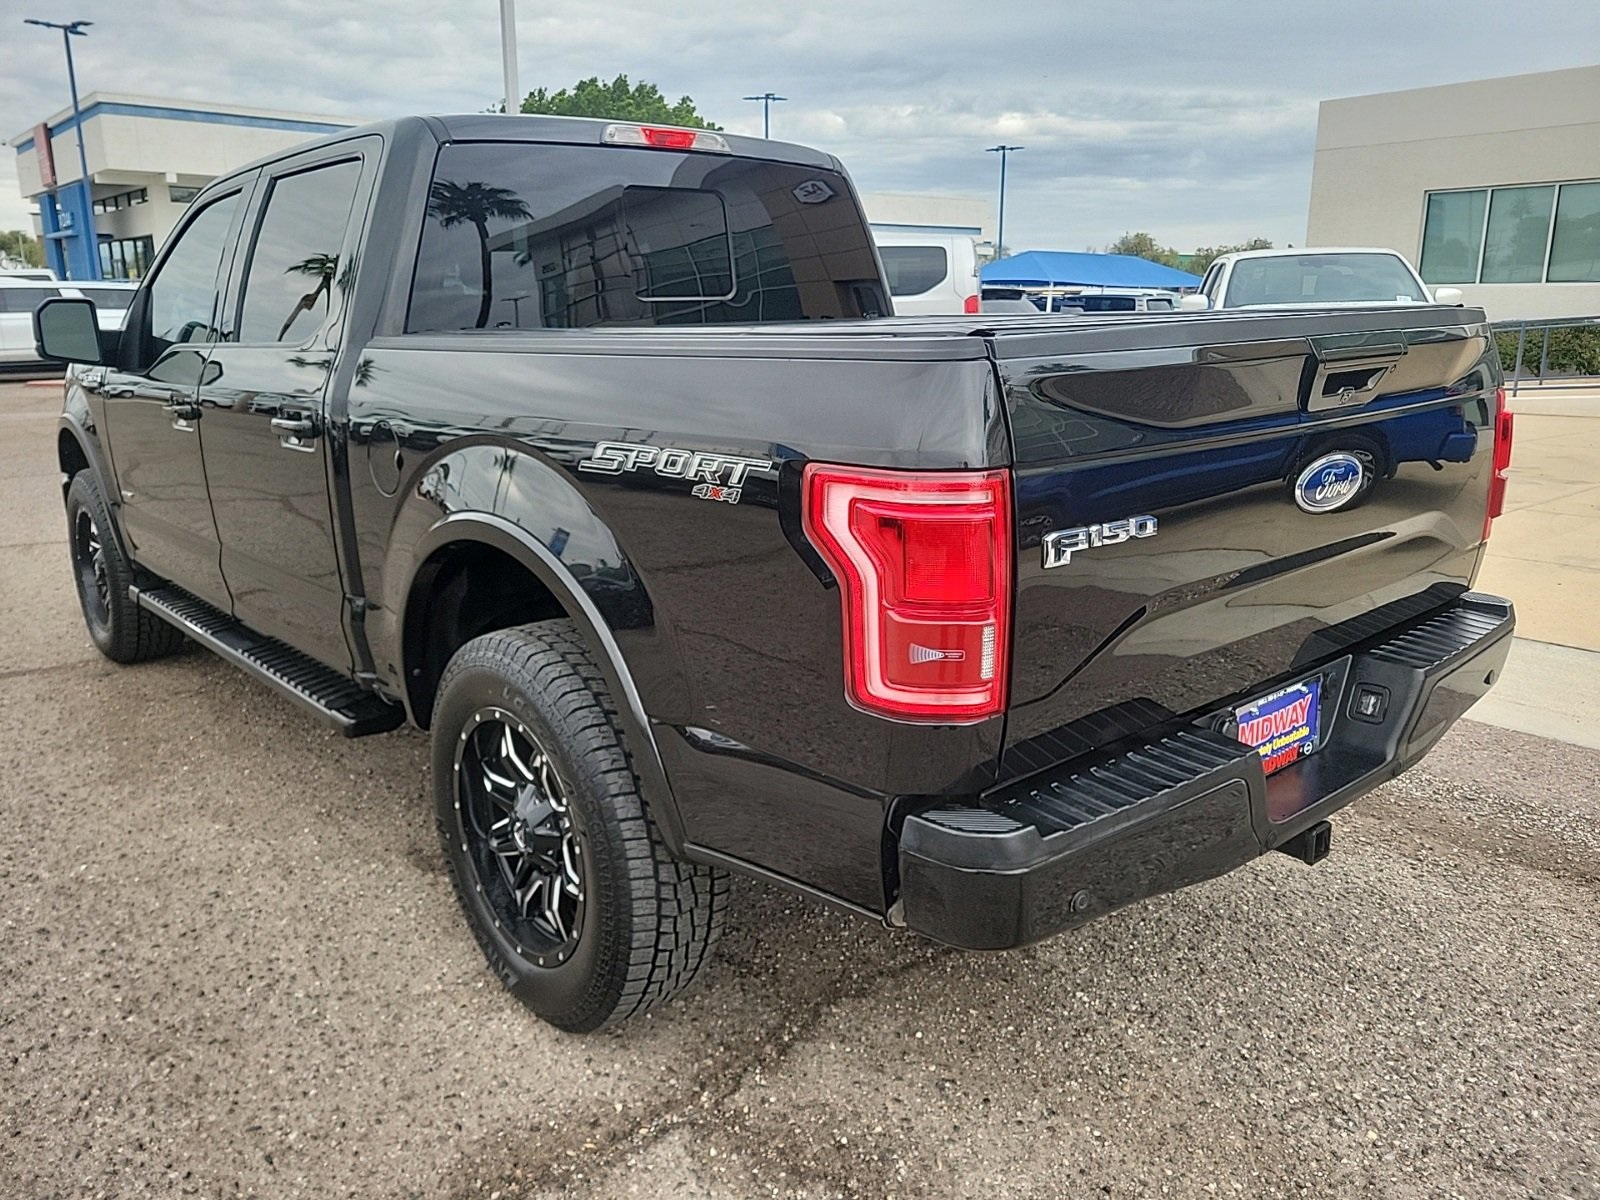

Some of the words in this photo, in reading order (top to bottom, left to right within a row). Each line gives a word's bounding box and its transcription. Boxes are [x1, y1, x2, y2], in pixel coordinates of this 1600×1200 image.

[578, 441, 772, 487] SPORT
[1315, 467, 1353, 500] Ford
[1238, 693, 1312, 747] MIDWAY
